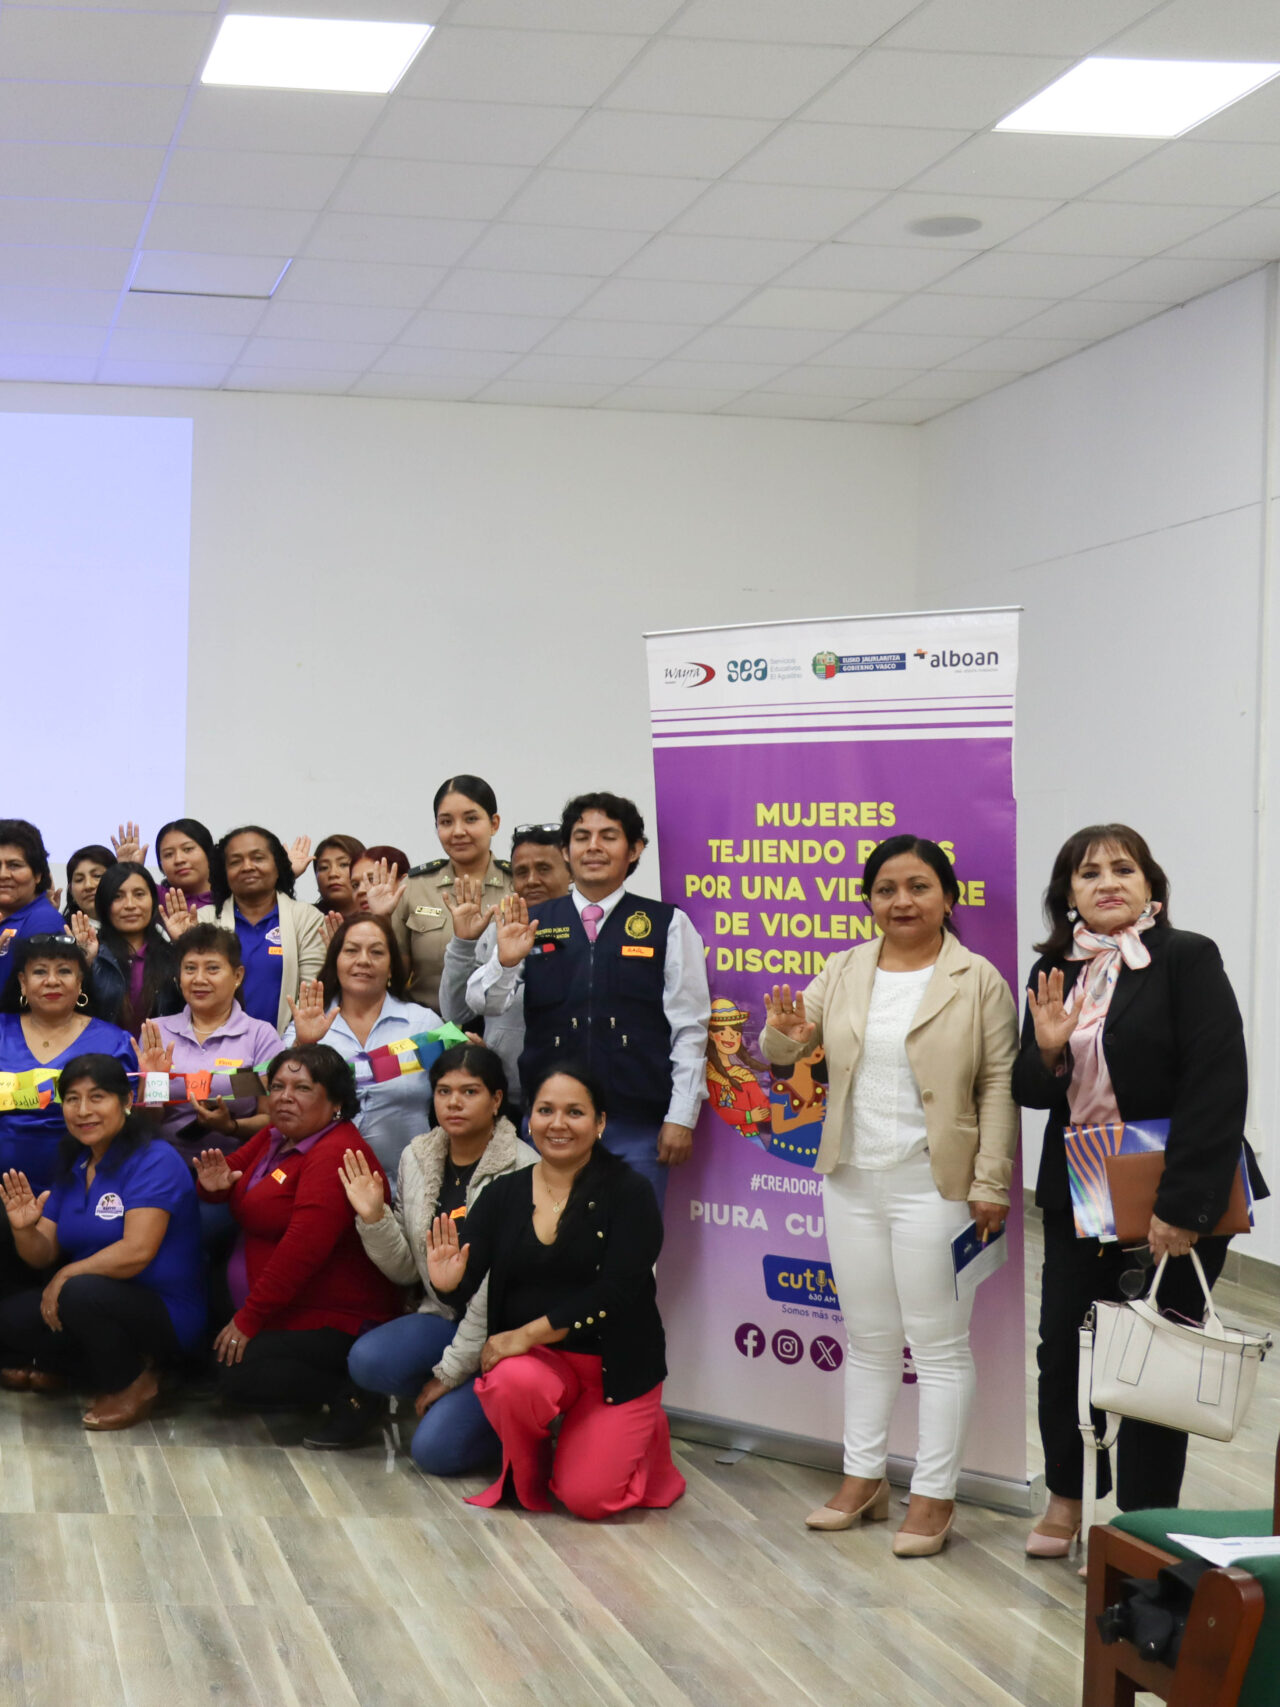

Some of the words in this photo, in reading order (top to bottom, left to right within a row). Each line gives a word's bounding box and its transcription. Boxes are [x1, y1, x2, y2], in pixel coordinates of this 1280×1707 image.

[727, 658, 768, 682] sea
[842, 656, 861, 664] EUSKO
[842, 664, 875, 672] GOBIERNO
[931, 650, 998, 668] alboan
[756, 802, 896, 827] MUJERES
[708, 839, 845, 864] TEJIENDO
[685, 874, 732, 899] POR
[741, 876, 806, 901] UNA
[815, 877, 869, 902] VID
[715, 911, 750, 936] DE
[760, 912, 884, 940] VIOLEN
[716, 947, 837, 976] DISCRIM
[750, 1174, 824, 1196] #CREADORA
[690, 1200, 769, 1231] PIURA
[808, 1293, 823, 1303] 630
[824, 1295, 837, 1304] AM
[782, 1303, 810, 1317] Somos
[812, 1309, 830, 1320] más
[831, 1313, 845, 1324] qu
